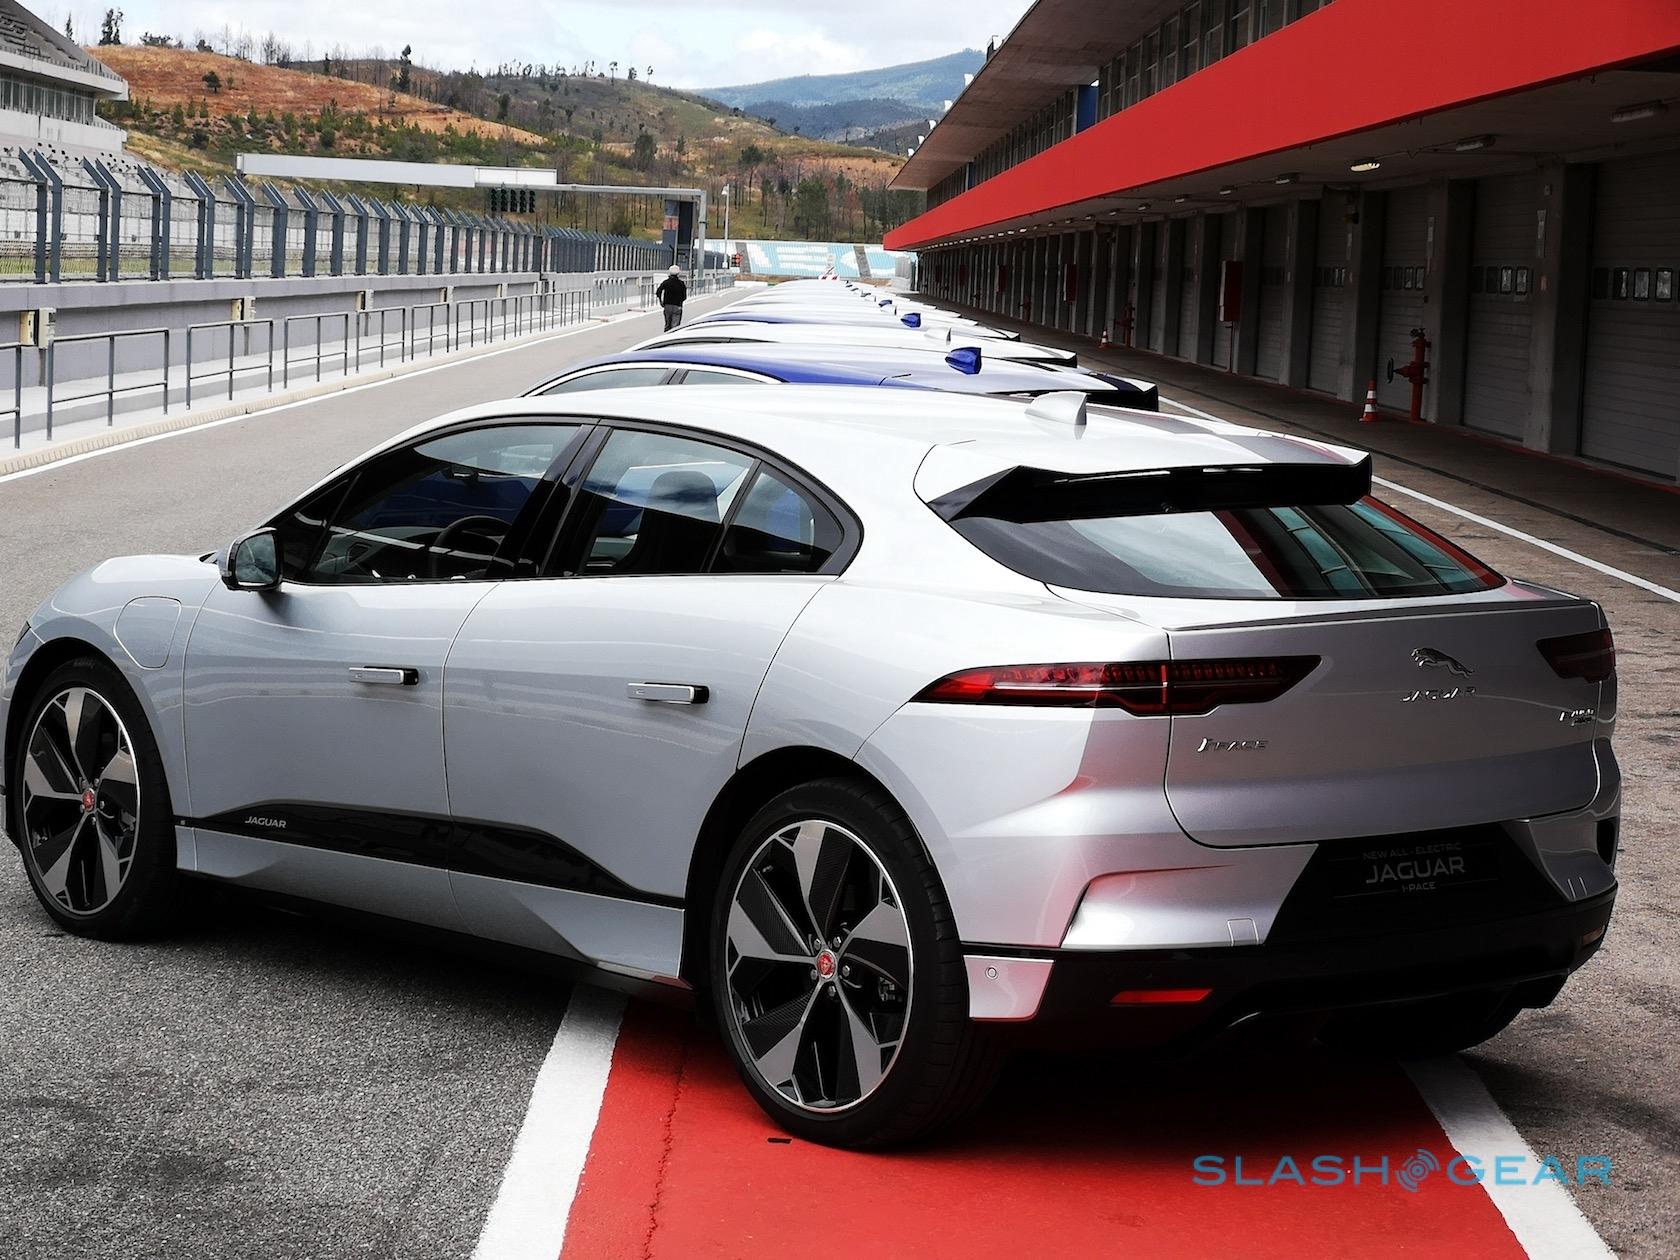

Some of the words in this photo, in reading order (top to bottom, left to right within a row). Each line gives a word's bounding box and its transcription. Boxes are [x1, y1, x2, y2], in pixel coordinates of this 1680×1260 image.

[244, 815, 287, 829] JAGUAR
[1362, 850, 1388, 860] NEW
[1366, 856, 1466, 884] JAGUAR
